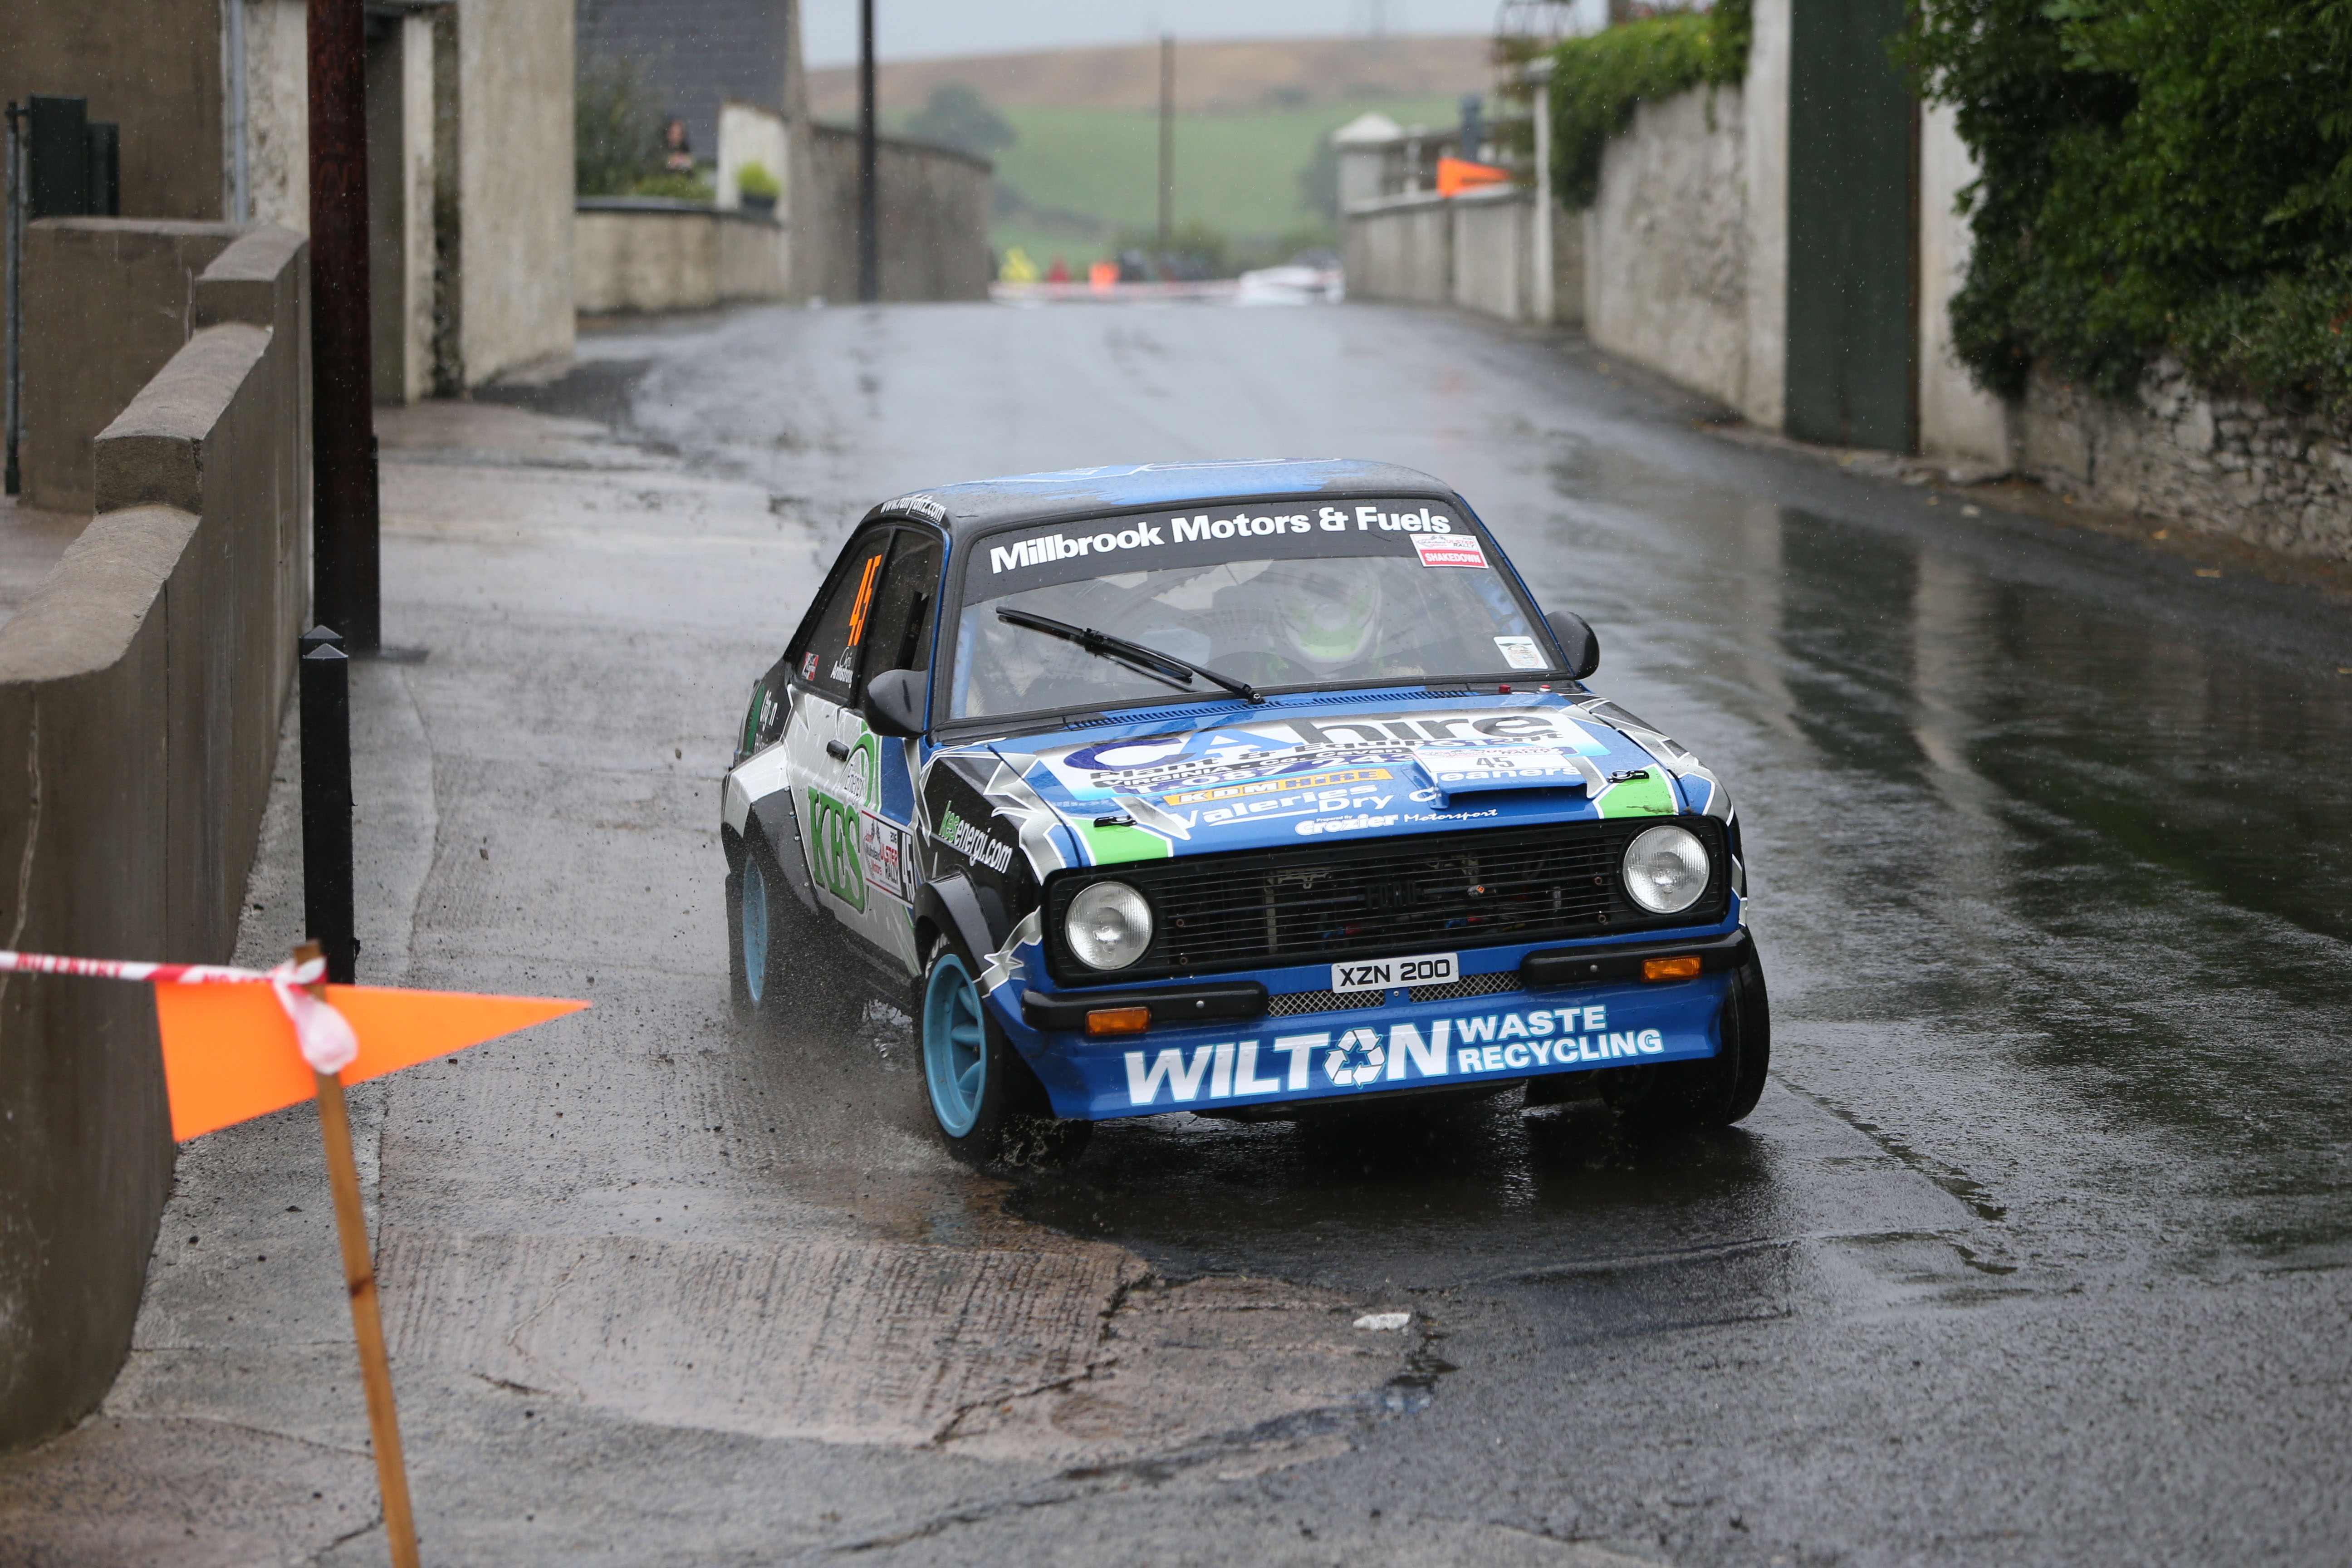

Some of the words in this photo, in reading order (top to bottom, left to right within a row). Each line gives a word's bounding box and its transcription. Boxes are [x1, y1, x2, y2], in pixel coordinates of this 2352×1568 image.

[990, 522, 1165, 574] Millbrook
[1171, 513, 1311, 543] Motors
[1318, 507, 1349, 532] &
[1355, 506, 1451, 533] Fuels
[1425, 553, 1481, 563] SHAKEDOWN
[847, 554, 882, 646] 45
[1090, 757, 1219, 779] Plant
[1239, 751, 1277, 761] &
[1102, 765, 1234, 786] VIRGINIA
[1316, 749, 1403, 758] Cavan
[1476, 757, 1515, 768] 45
[1178, 784, 1378, 828] Valeries
[1180, 782, 1279, 803] KDM
[1318, 795, 1394, 812] Dry
[1295, 814, 1398, 835] Crozier
[1404, 809, 1498, 823] Motorsport
[808, 786, 864, 914] KES
[938, 800, 1013, 873] kesenergi.com
[880, 843, 898, 867] ULSTER
[885, 861, 898, 885] RALLY
[1339, 964, 1391, 987] XZN
[1400, 959, 1450, 981] 200
[1455, 1004, 1607, 1044] WASTE
[1456, 1029, 1664, 1075] RECYCLING
